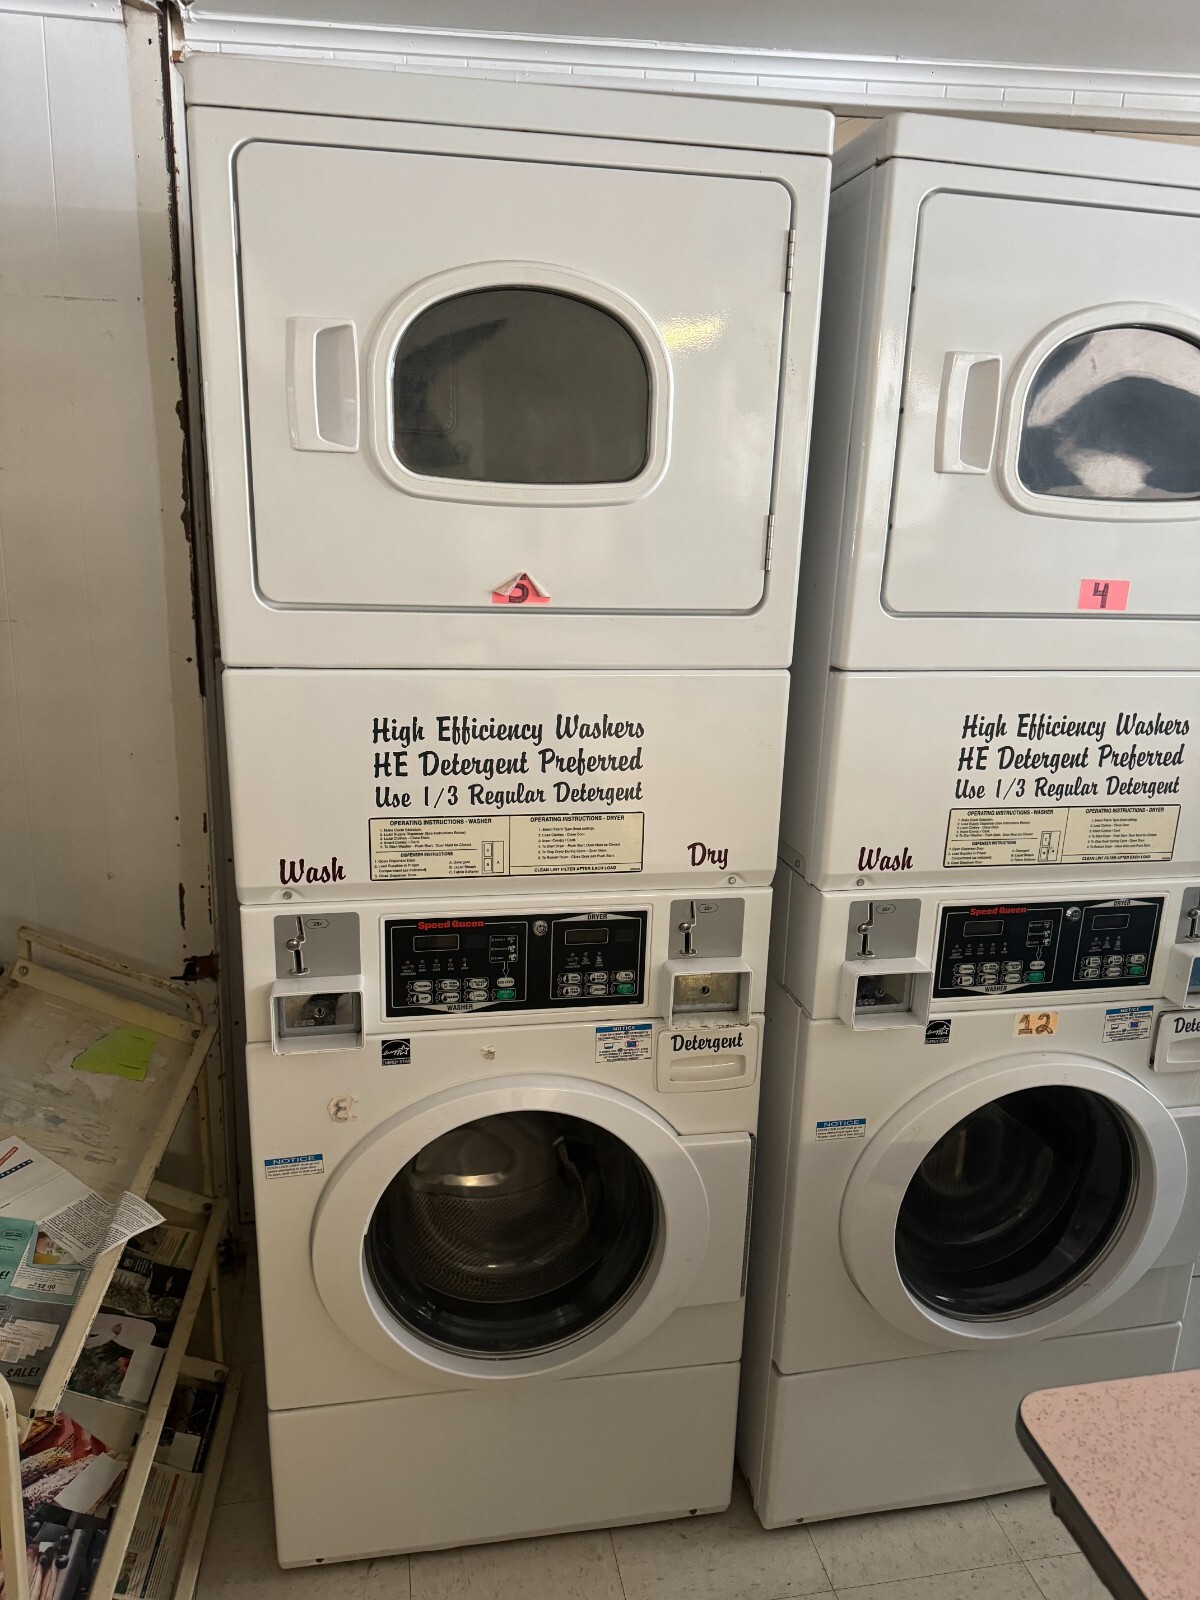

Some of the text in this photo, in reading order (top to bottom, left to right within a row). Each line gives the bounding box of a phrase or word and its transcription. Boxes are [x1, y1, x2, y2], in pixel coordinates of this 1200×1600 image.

[1092, 582, 1109, 609] 4
[372, 714, 644, 748] High Efficiency Washers
[962, 712, 1189, 743] High Efficiency Washers
[374, 747, 643, 780] HE Detergent Preferred
[957, 743, 1185, 774] HE Detergent Preferred
[376, 786, 411, 808] Use
[468, 783, 546, 809] Regular
[553, 782, 643, 806] Detergent
[955, 779, 985, 799] Use
[1035, 776, 1098, 801] Regular
[1106, 776, 1180, 799] Detergent
[687, 842, 728, 870] Dry
[858, 847, 913, 871] Wash
[280, 857, 346, 885] Wash
[969, 906, 1027, 917] Speed Queen
[417, 920, 485, 930] Speed Queen
[1018, 1012, 1053, 1035] 12
[671, 1030, 743, 1052] Detergent
[823, 1120, 860, 1128] NOTICE
[272, 1156, 315, 1165] NOTICE
[5, 1366, 40, 1378] SALE!
